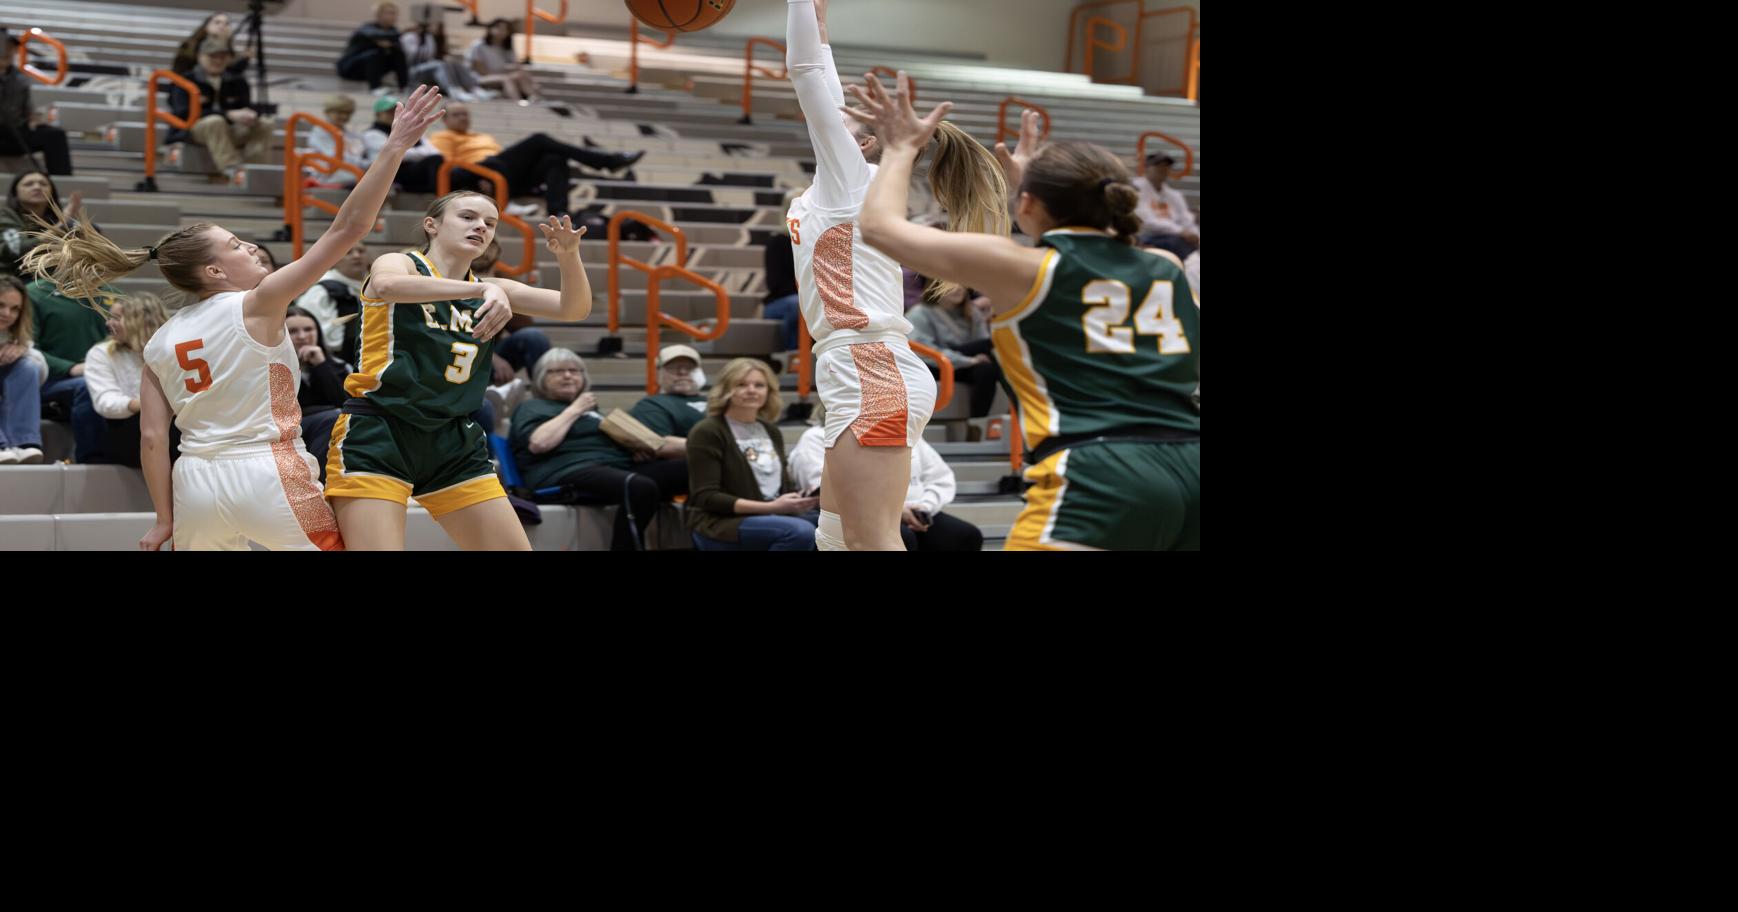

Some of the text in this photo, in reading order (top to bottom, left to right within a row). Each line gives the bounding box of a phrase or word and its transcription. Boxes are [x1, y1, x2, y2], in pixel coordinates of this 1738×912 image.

[1081, 279, 1192, 354] 24
[175, 338, 213, 394] 5
[444, 341, 479, 385] 3
